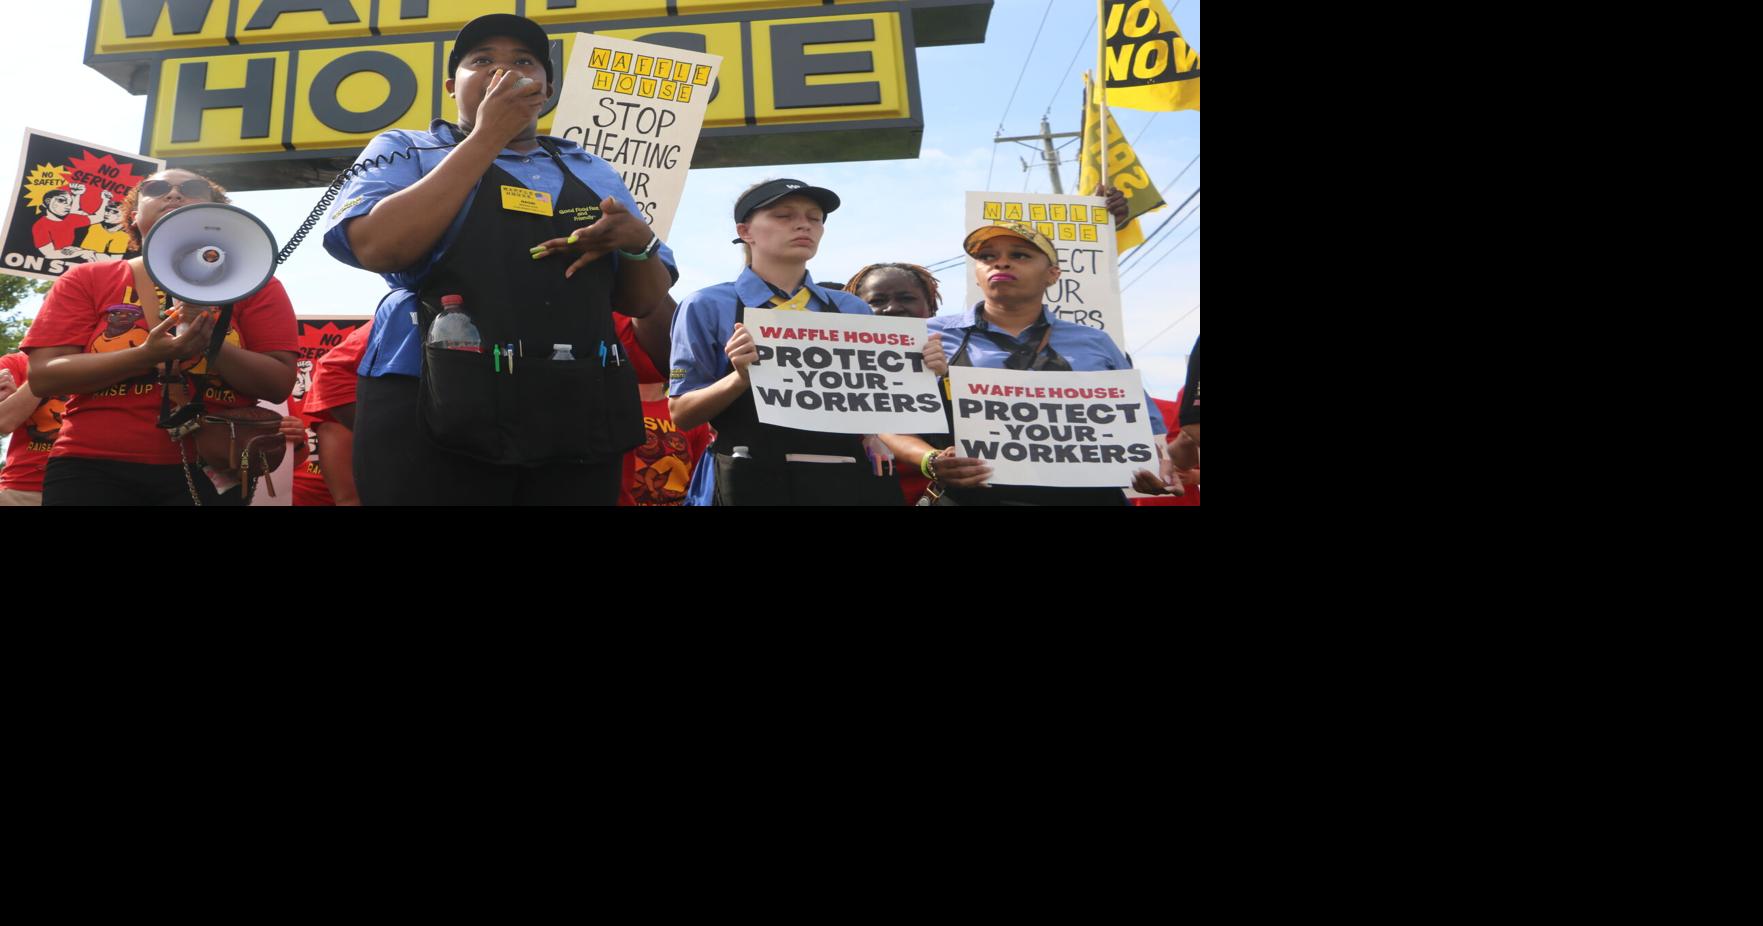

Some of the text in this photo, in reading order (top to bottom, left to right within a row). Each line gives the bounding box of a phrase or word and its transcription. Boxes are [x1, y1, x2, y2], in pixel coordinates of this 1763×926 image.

[589, 49, 710, 84] WAFFLE
[595, 72, 693, 101] HOUSE
[592, 97, 676, 138] STOP
[98, 164, 120, 178] NO
[985, 203, 1107, 221] WAFFLE
[4, 253, 46, 271] ON
[320, 333, 343, 347] NO
[759, 326, 915, 346] WAFFLE HOUSE:
[752, 344, 925, 373] PROTECT
[134, 384, 154, 395] UP
[756, 385, 942, 414] WORKERS
[968, 383, 1126, 399] WAFFLE HOUSE:
[958, 398, 1141, 425] PROTECT
[960, 439, 1153, 464] WORKERS
